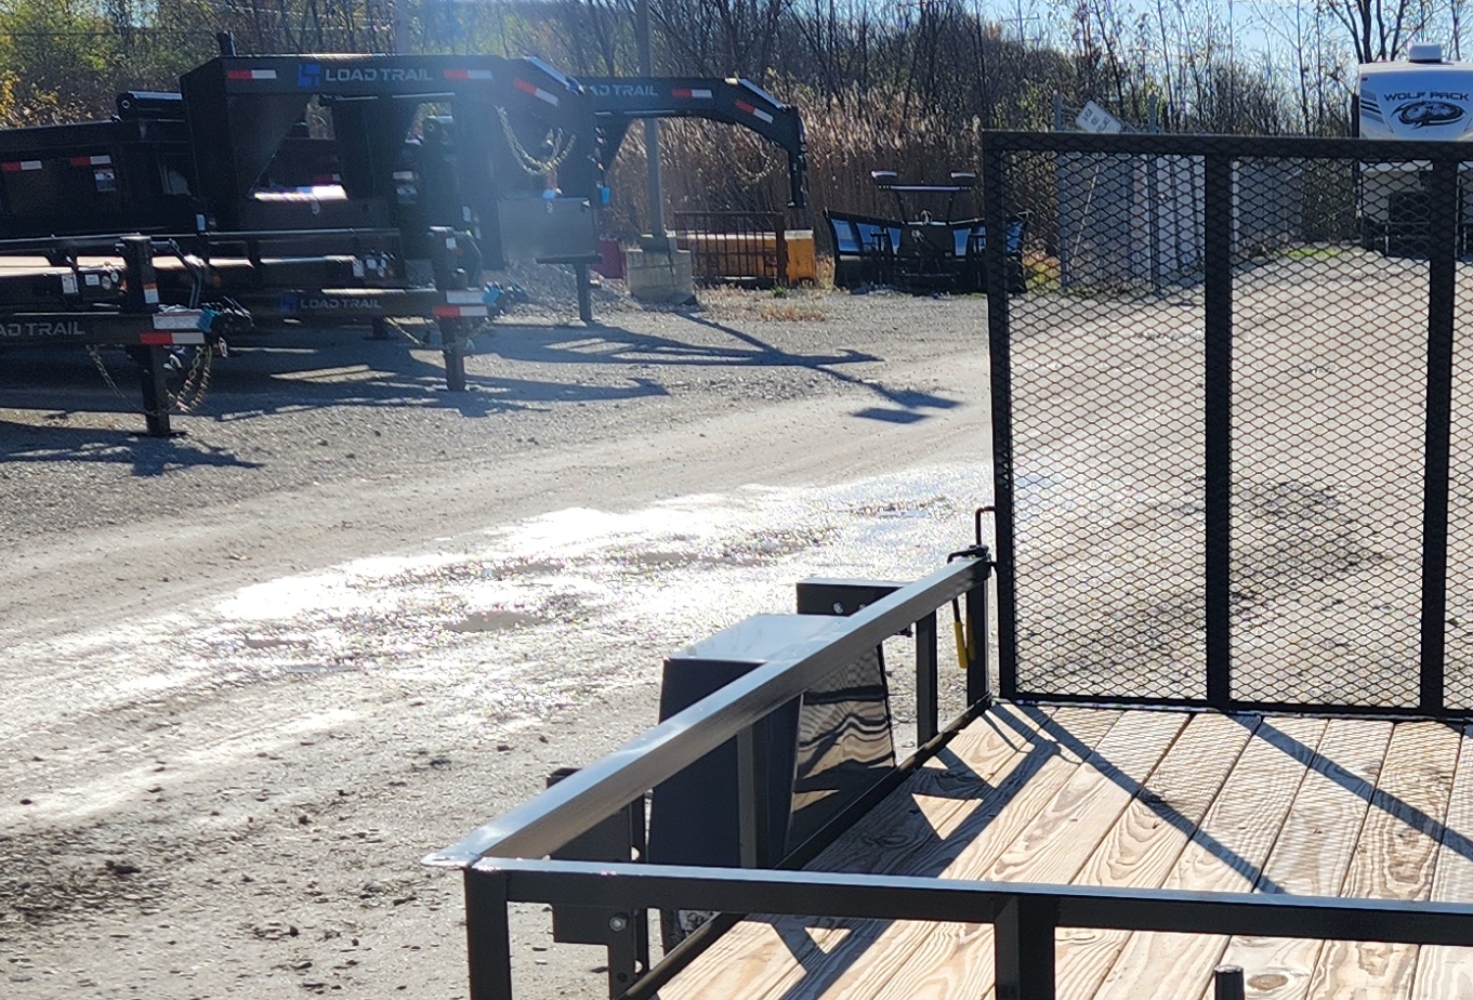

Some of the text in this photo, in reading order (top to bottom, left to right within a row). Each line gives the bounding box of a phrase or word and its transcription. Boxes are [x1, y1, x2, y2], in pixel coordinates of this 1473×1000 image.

[612, 85, 659, 96] TRAIL
[1384, 91, 1469, 102] WOLF PACK
[25, 321, 86, 336] TRAIL
